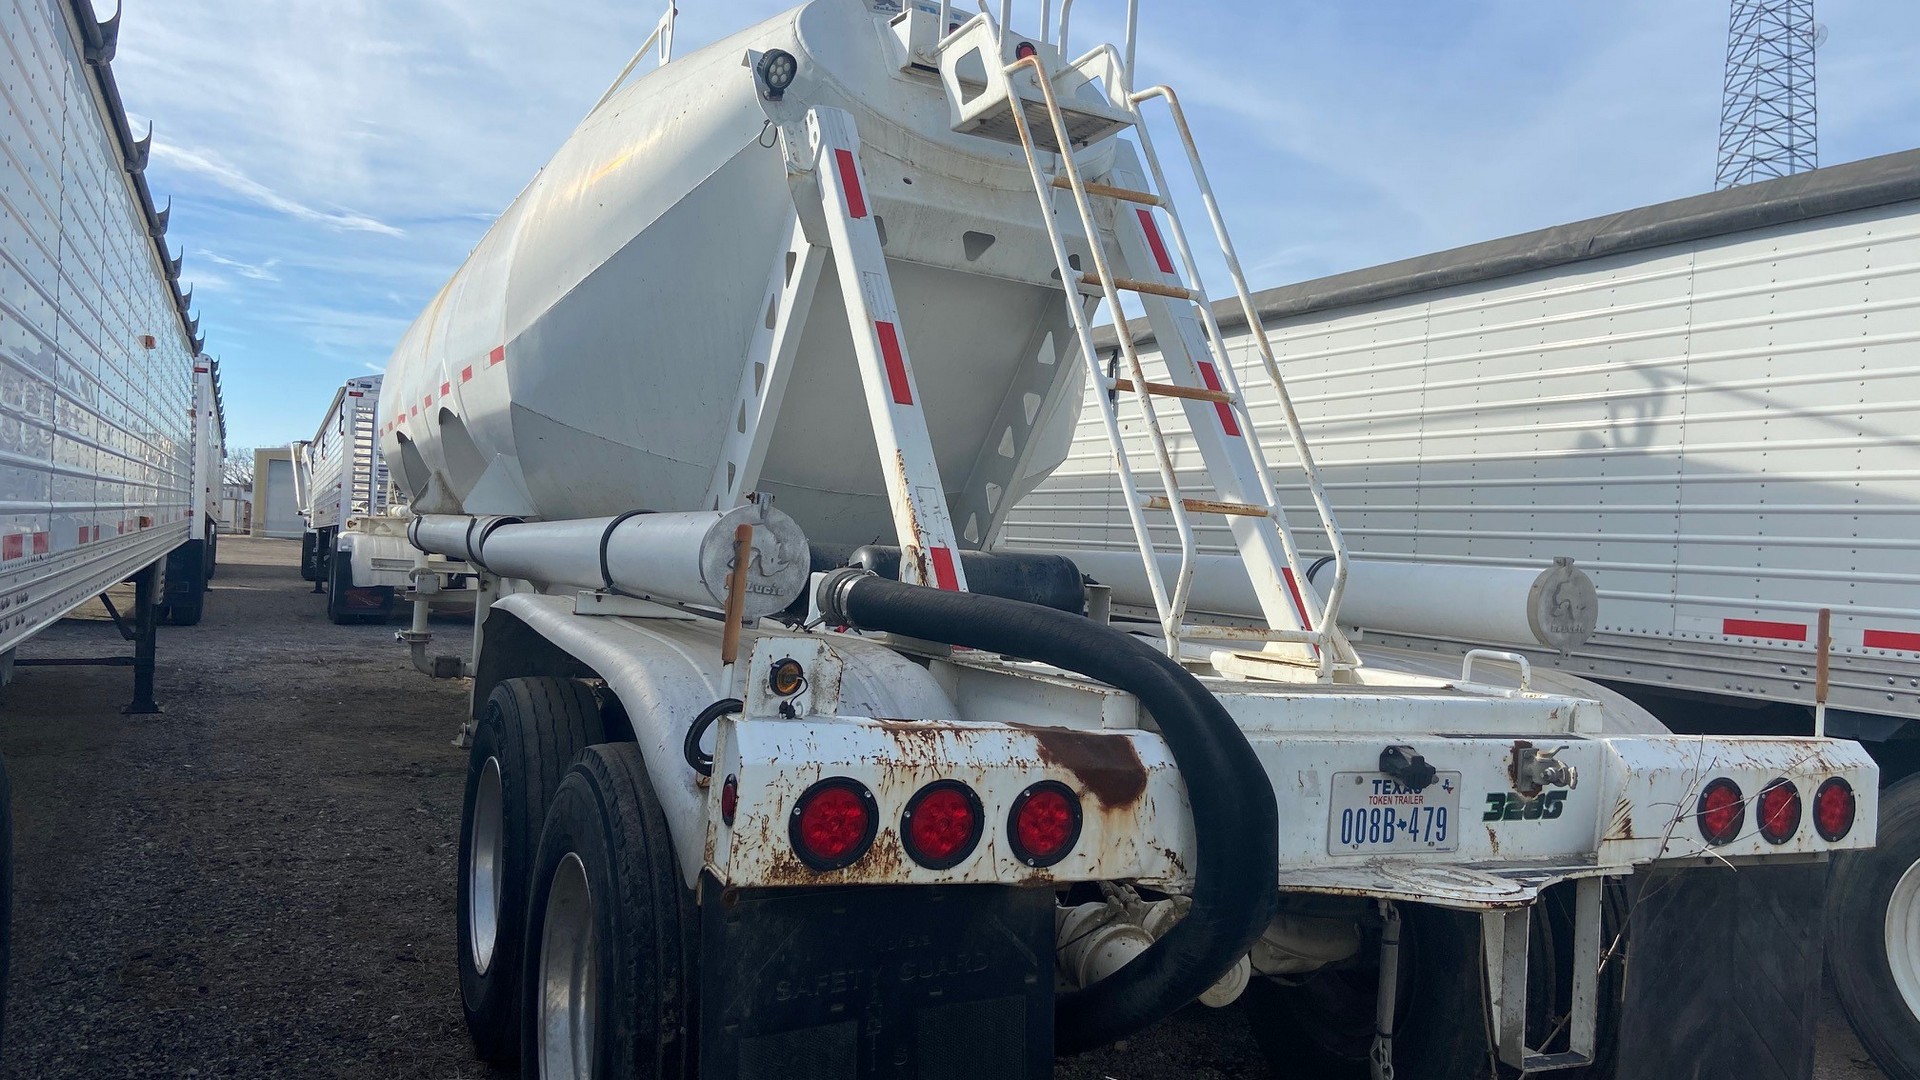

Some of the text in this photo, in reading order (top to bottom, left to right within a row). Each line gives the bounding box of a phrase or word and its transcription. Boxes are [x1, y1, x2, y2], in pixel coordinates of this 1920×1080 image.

[1369, 795, 1424, 805] TOKEN TRAILER
[1341, 806, 1448, 845] 008B 479
